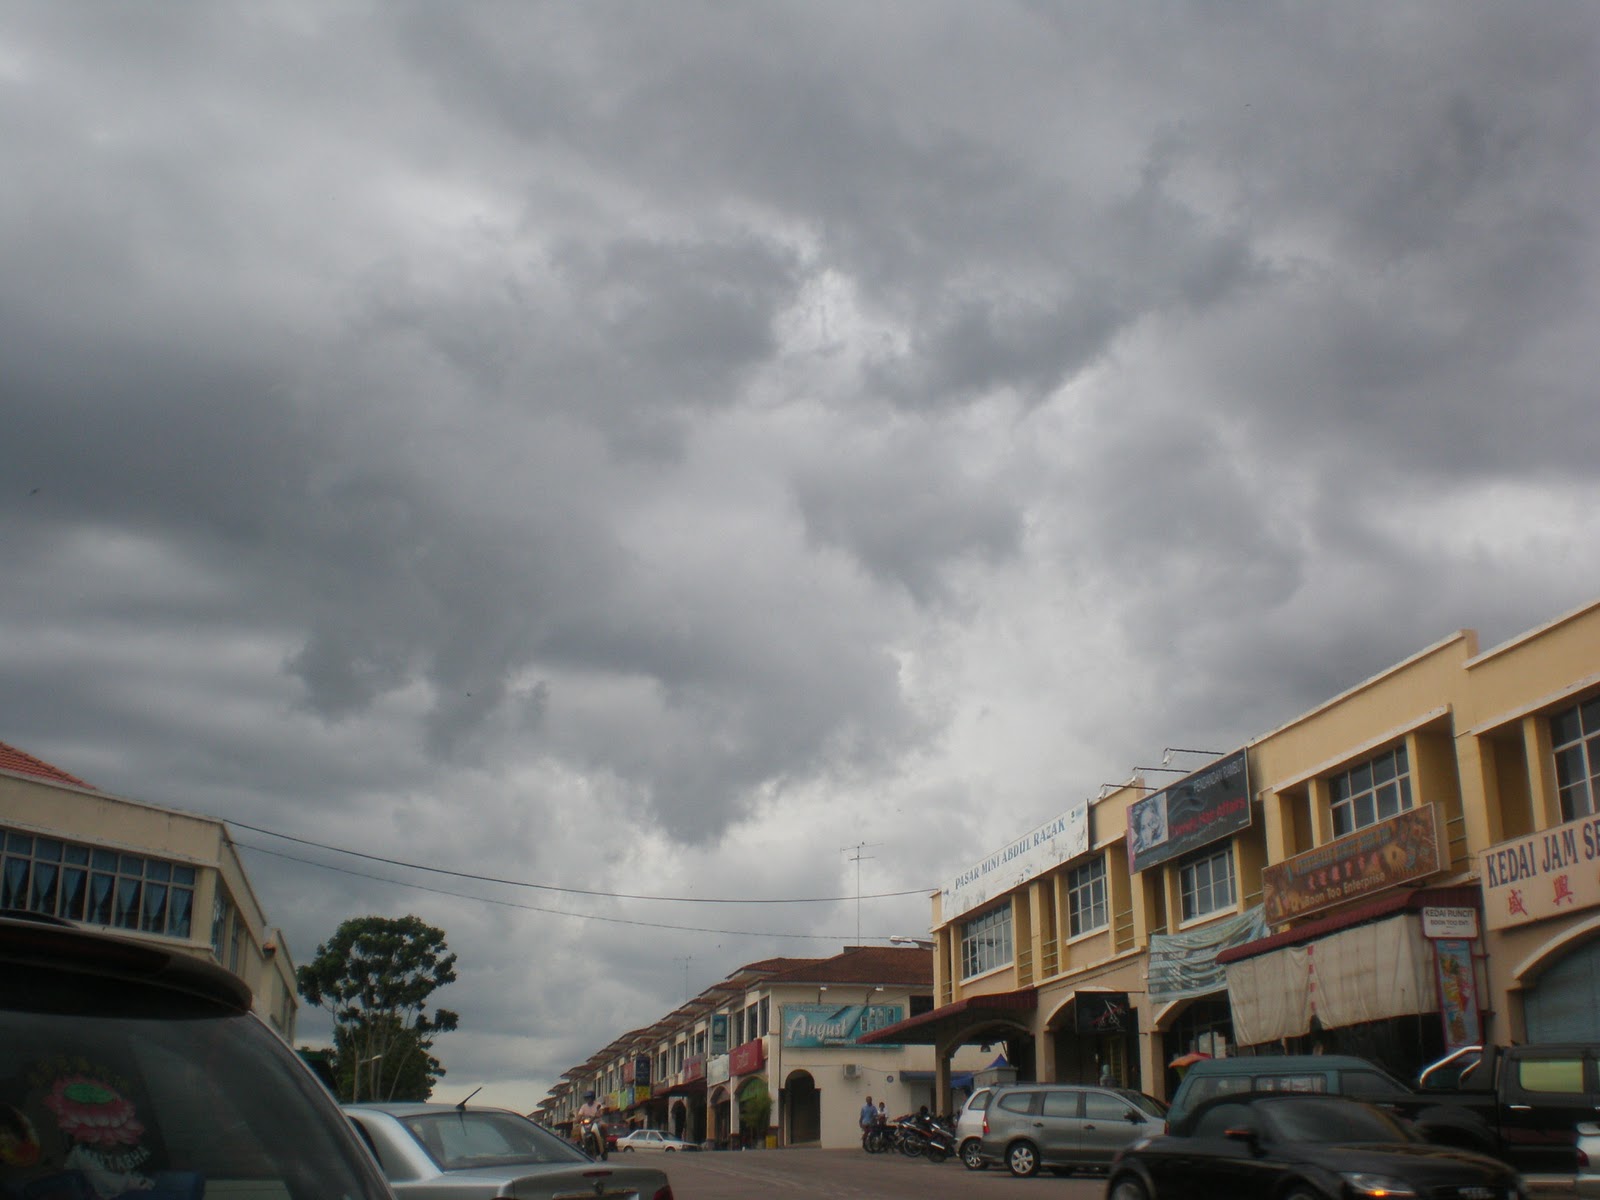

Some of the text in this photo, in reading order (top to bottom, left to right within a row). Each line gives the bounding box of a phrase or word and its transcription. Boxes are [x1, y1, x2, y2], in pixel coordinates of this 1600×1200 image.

[955, 817, 1066, 890] PASAR MINI ABDUL RAZAK
[1486, 841, 1537, 889] KEDAI
[1542, 828, 1579, 873] JAM
[1343, 872, 1386, 895] Enterprise
[1425, 909, 1474, 918] KEDAI RUNCIT
[787, 1013, 847, 1043] August
